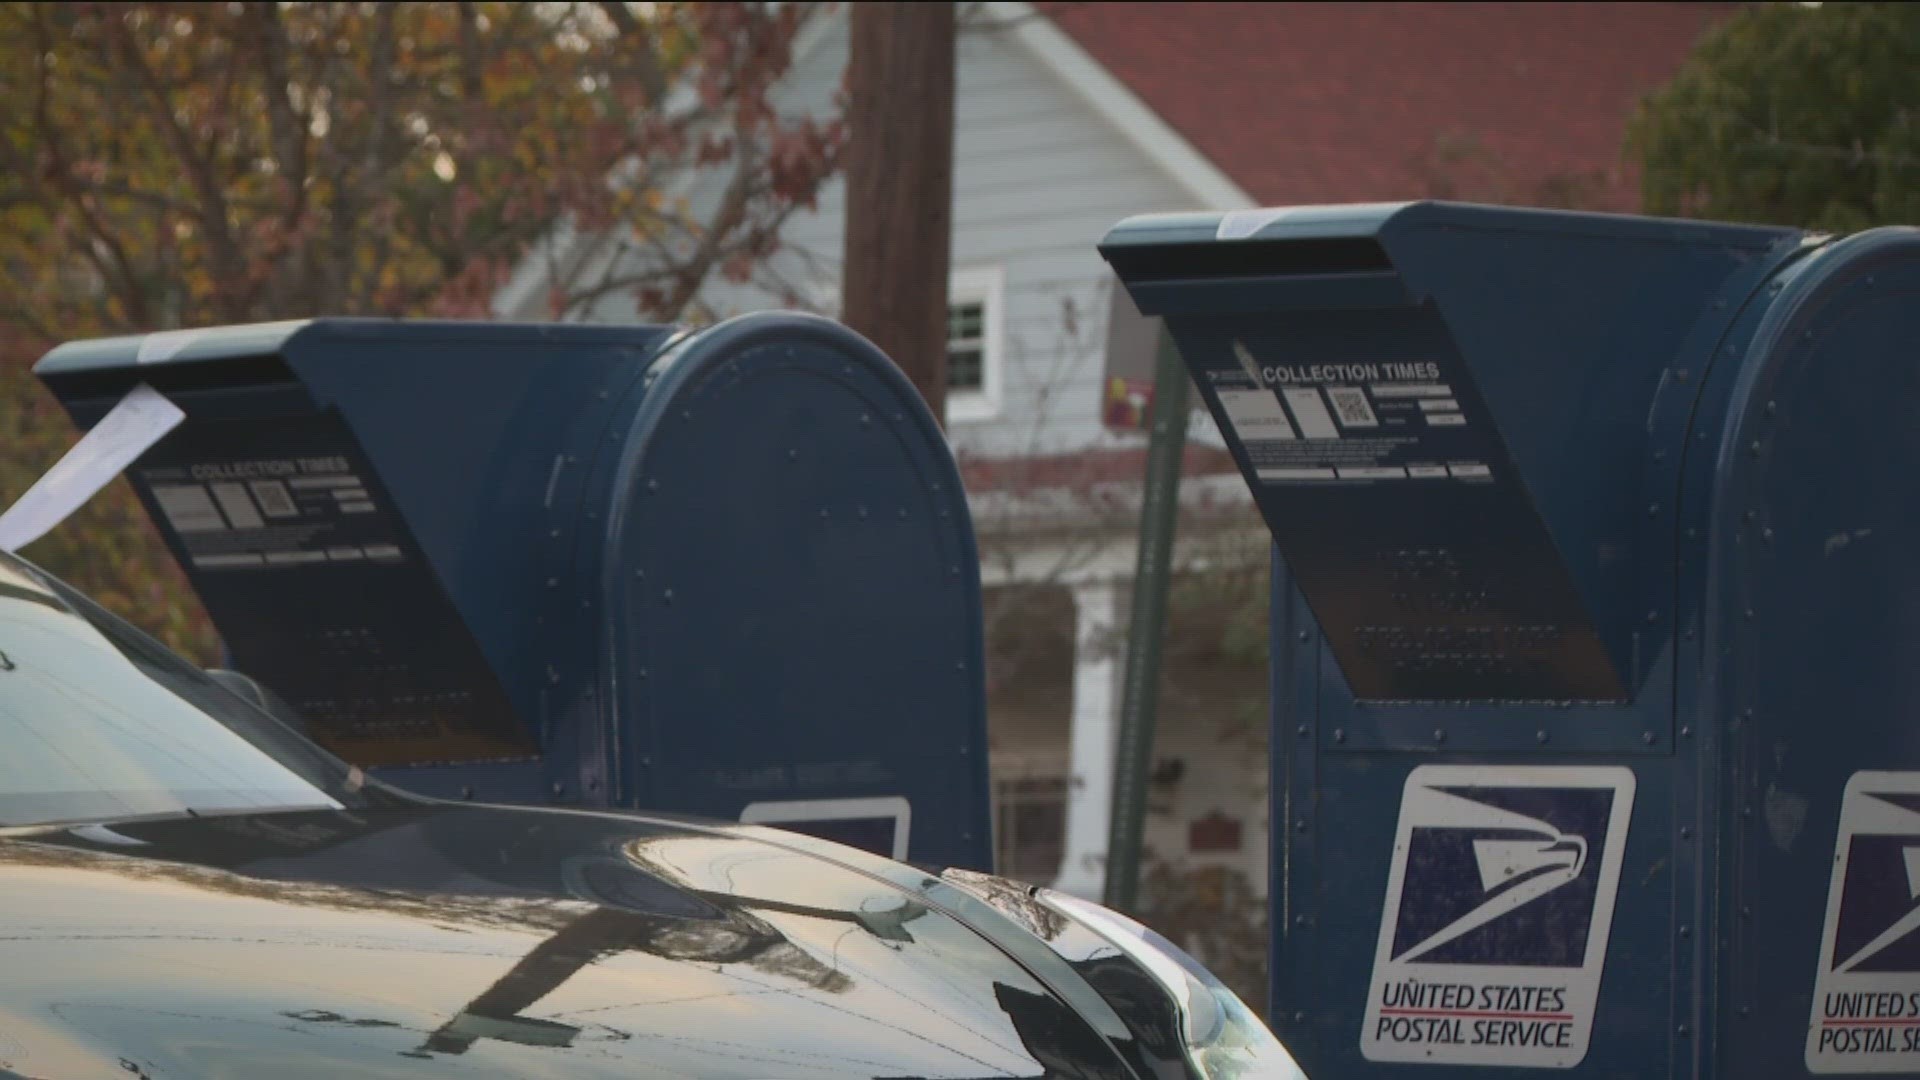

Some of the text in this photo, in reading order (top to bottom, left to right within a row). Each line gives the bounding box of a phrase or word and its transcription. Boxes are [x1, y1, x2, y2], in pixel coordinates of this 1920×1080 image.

[1262, 364, 1380, 383] COLLECTION
[1382, 362, 1441, 380] TIMES
[190, 459, 297, 480] COLLECTION
[296, 456, 350, 473] TIMES
[1381, 982, 1566, 1012] UNITED STATES
[1824, 991, 1905, 1018] UNITED
[1375, 1017, 1574, 1048] POSTAL SERVICE
[1818, 1027, 1897, 1054] POSTAL
